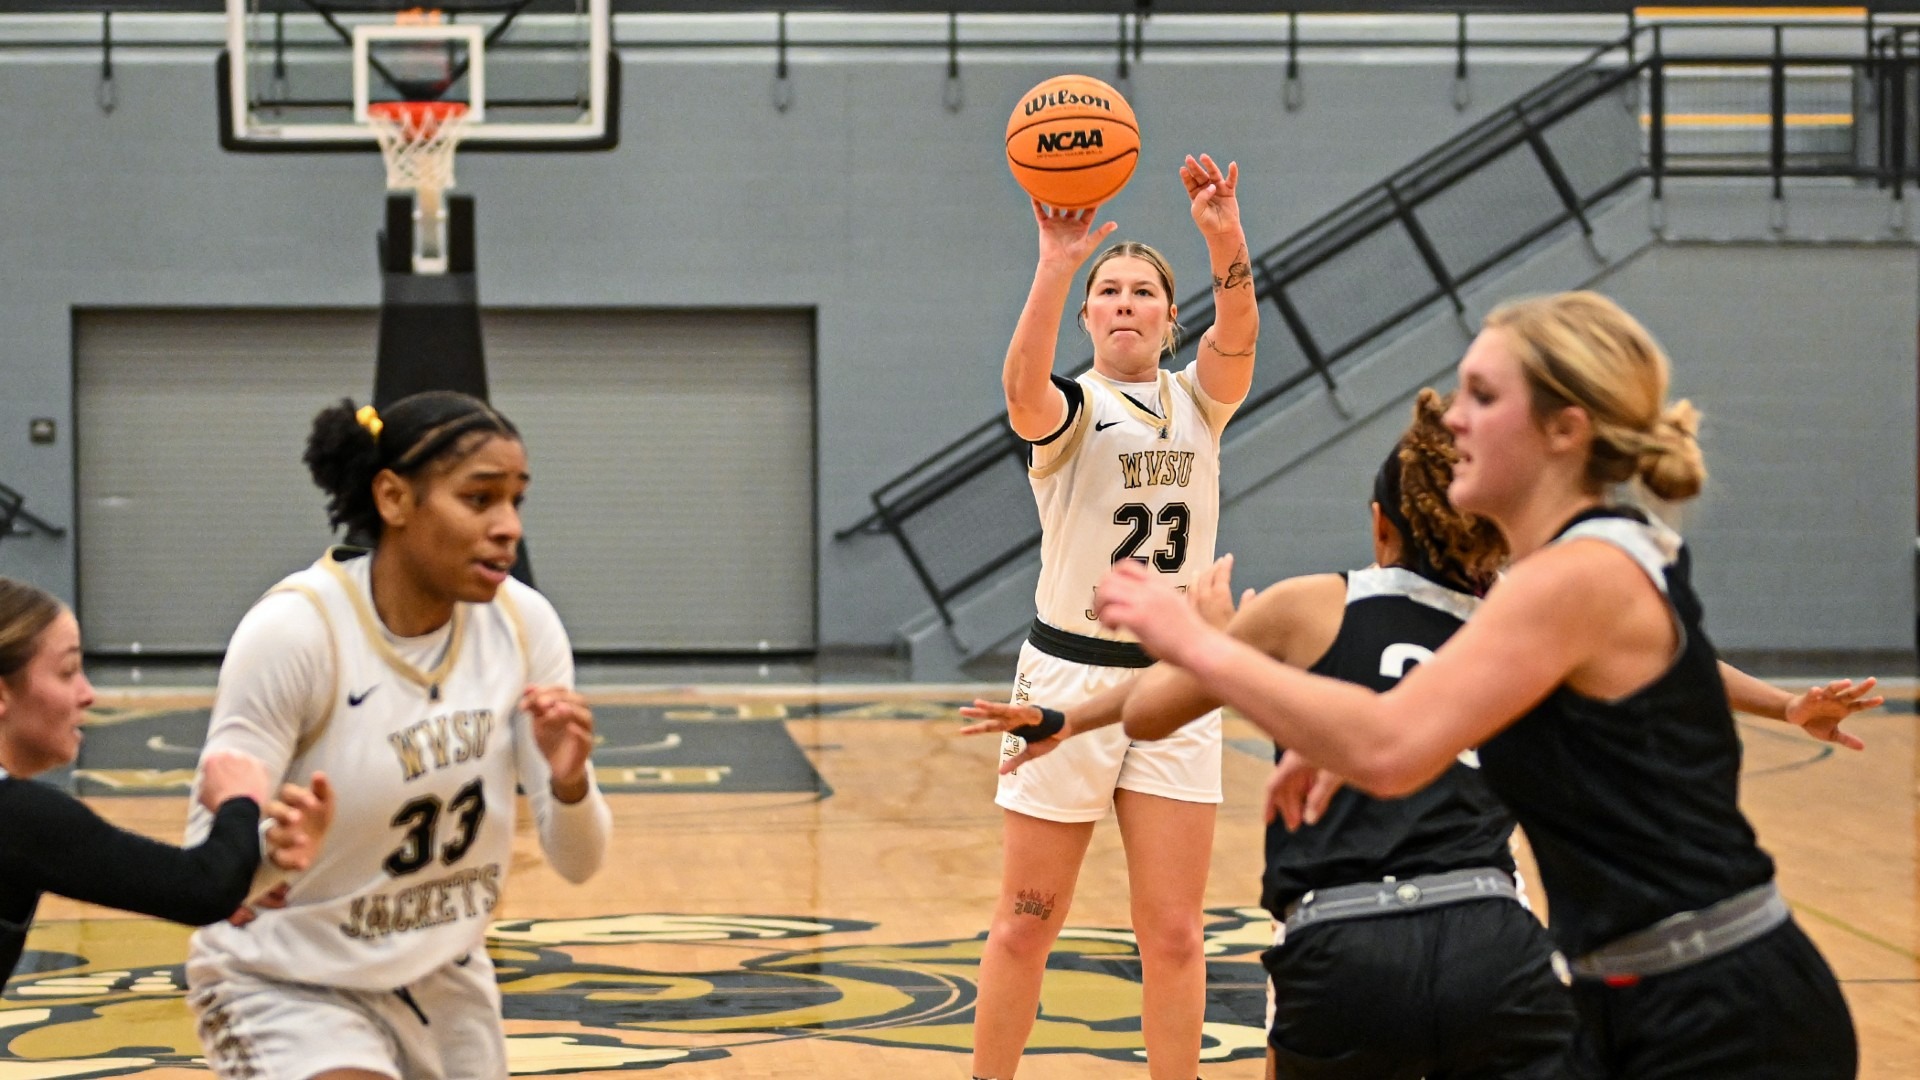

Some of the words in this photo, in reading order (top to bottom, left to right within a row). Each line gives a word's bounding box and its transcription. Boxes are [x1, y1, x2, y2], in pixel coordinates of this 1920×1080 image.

[1025, 90, 1110, 116] Wilson
[1037, 129, 1103, 153] NCAA
[1119, 450, 1194, 489] WVSU
[1111, 502, 1190, 574] 23
[387, 709, 493, 782] WVSU
[383, 775, 486, 878] 33
[340, 863, 501, 940] JACKETS
